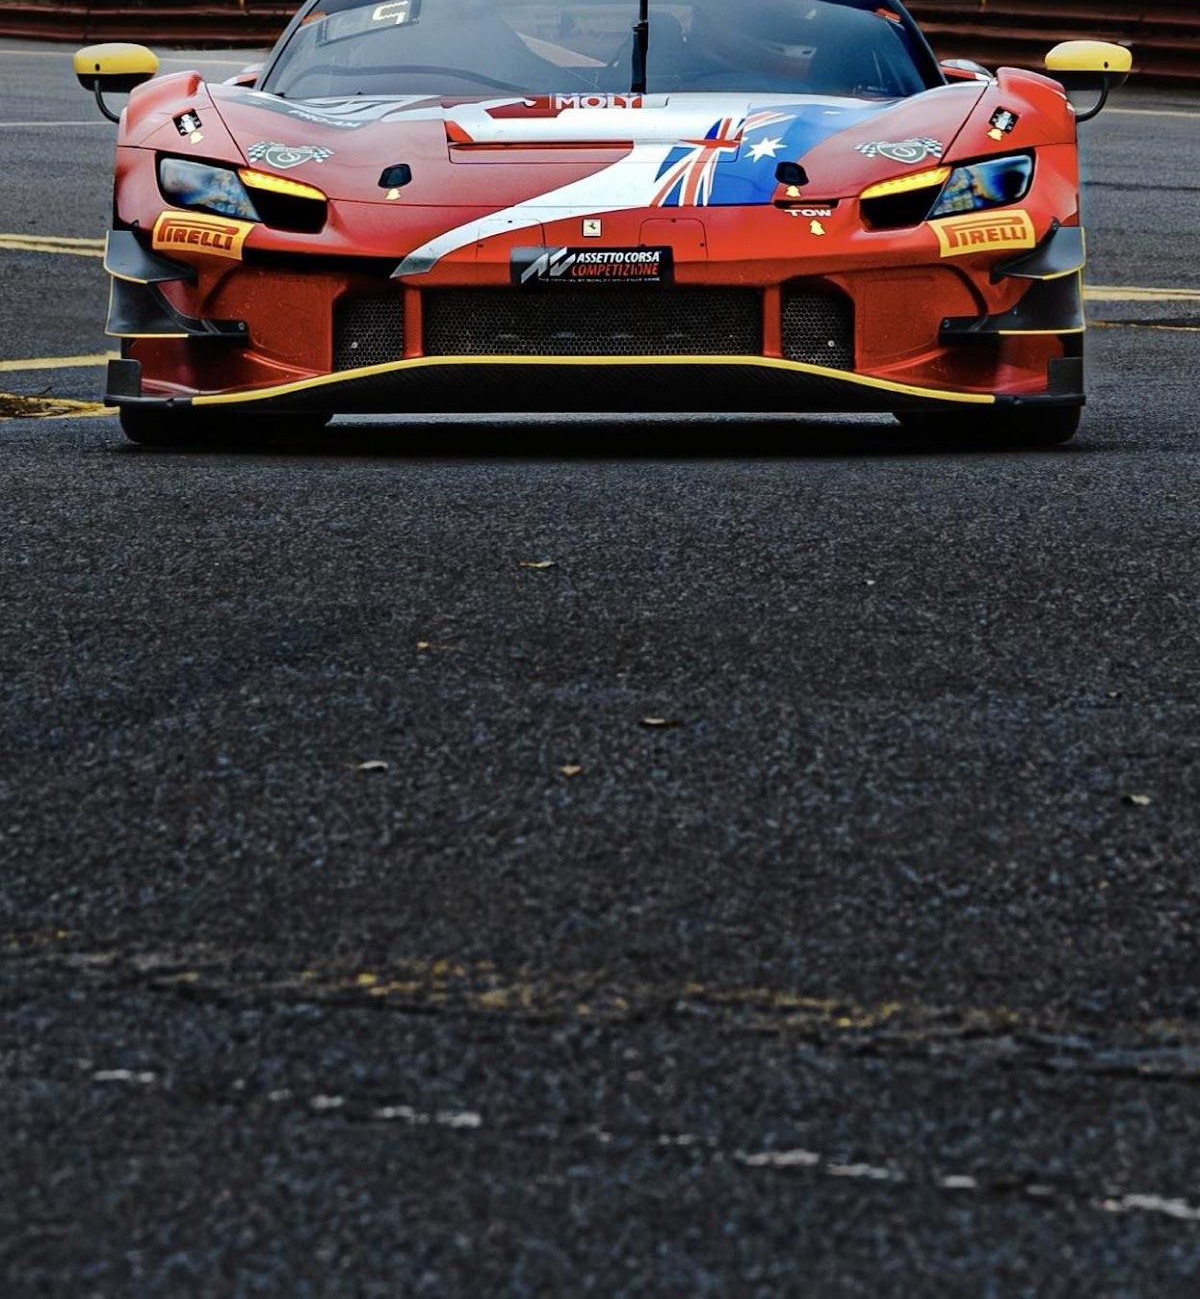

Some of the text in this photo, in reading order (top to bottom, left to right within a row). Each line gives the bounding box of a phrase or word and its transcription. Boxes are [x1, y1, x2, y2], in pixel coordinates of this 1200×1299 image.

[555, 93, 644, 110] MOLY
[784, 209, 832, 217] TOW
[157, 218, 240, 251] PIRELLI
[941, 216, 1027, 248] PIRELLI
[576, 251, 661, 264] ASSETTO CORSA
[571, 263, 659, 276] COMPETIZIONE
